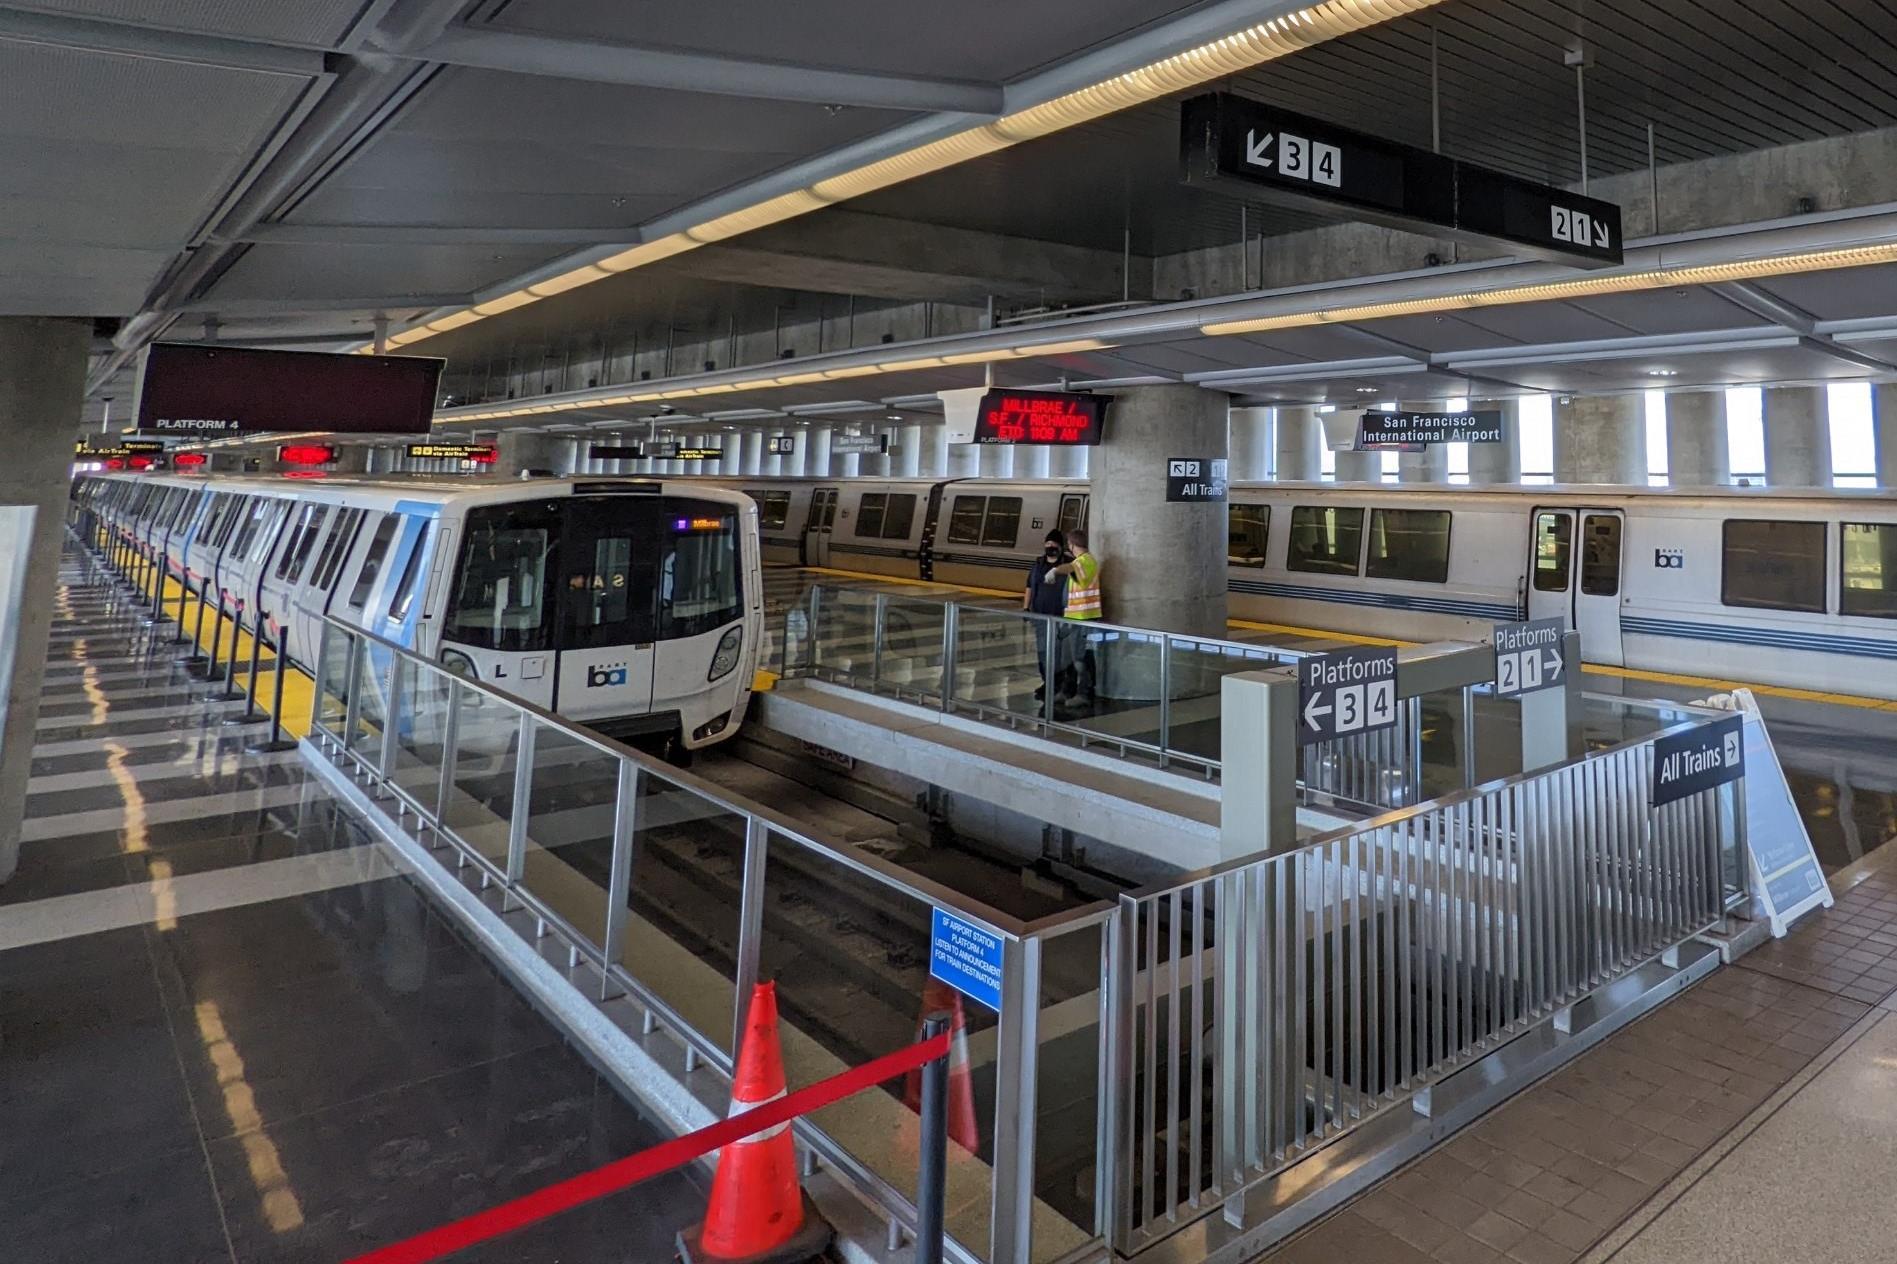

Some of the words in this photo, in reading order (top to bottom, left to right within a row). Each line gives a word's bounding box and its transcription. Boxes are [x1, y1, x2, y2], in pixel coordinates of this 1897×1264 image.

[1286, 141, 1301, 171] 3
[1318, 150, 1334, 180] 4
[1556, 212, 1567, 236] 2
[1577, 217, 1586, 241] 1
[1003, 399, 1064, 414] MILLBRAE
[156, 419, 226, 429] PLATFORM
[229, 420, 239, 430] 4
[1030, 413, 1089, 428] RICHMOND
[1384, 416, 1407, 428] San
[1413, 415, 1476, 428] Francisco
[1060, 428, 1078, 441] AM
[1363, 428, 1445, 442] International
[1452, 428, 1500, 443] Airport
[1189, 464, 1196, 475] 2
[1182, 483, 1197, 496] All
[1496, 626, 1557, 650] Platforms
[496, 664, 507, 678] L
[1310, 656, 1394, 687] Platforms
[1502, 659, 1514, 688] 2
[1527, 655, 1537, 683] 1
[1342, 692, 1357, 725] 3
[1374, 687, 1388, 718] 4
[1660, 753, 1679, 784] All
[1682, 744, 1721, 777] Trains
[950, 920, 973, 937] AIRPORT
[973, 931, 995, 950] STATION
[952, 933, 980, 954] PLATFORM
[935, 938, 951, 953] LISTEN
[951, 944, 959, 956] TO
[935, 949, 946, 962] FOR
[946, 953, 962, 970] TRAIN
[962, 962, 1001, 990] DESTINATIONS
